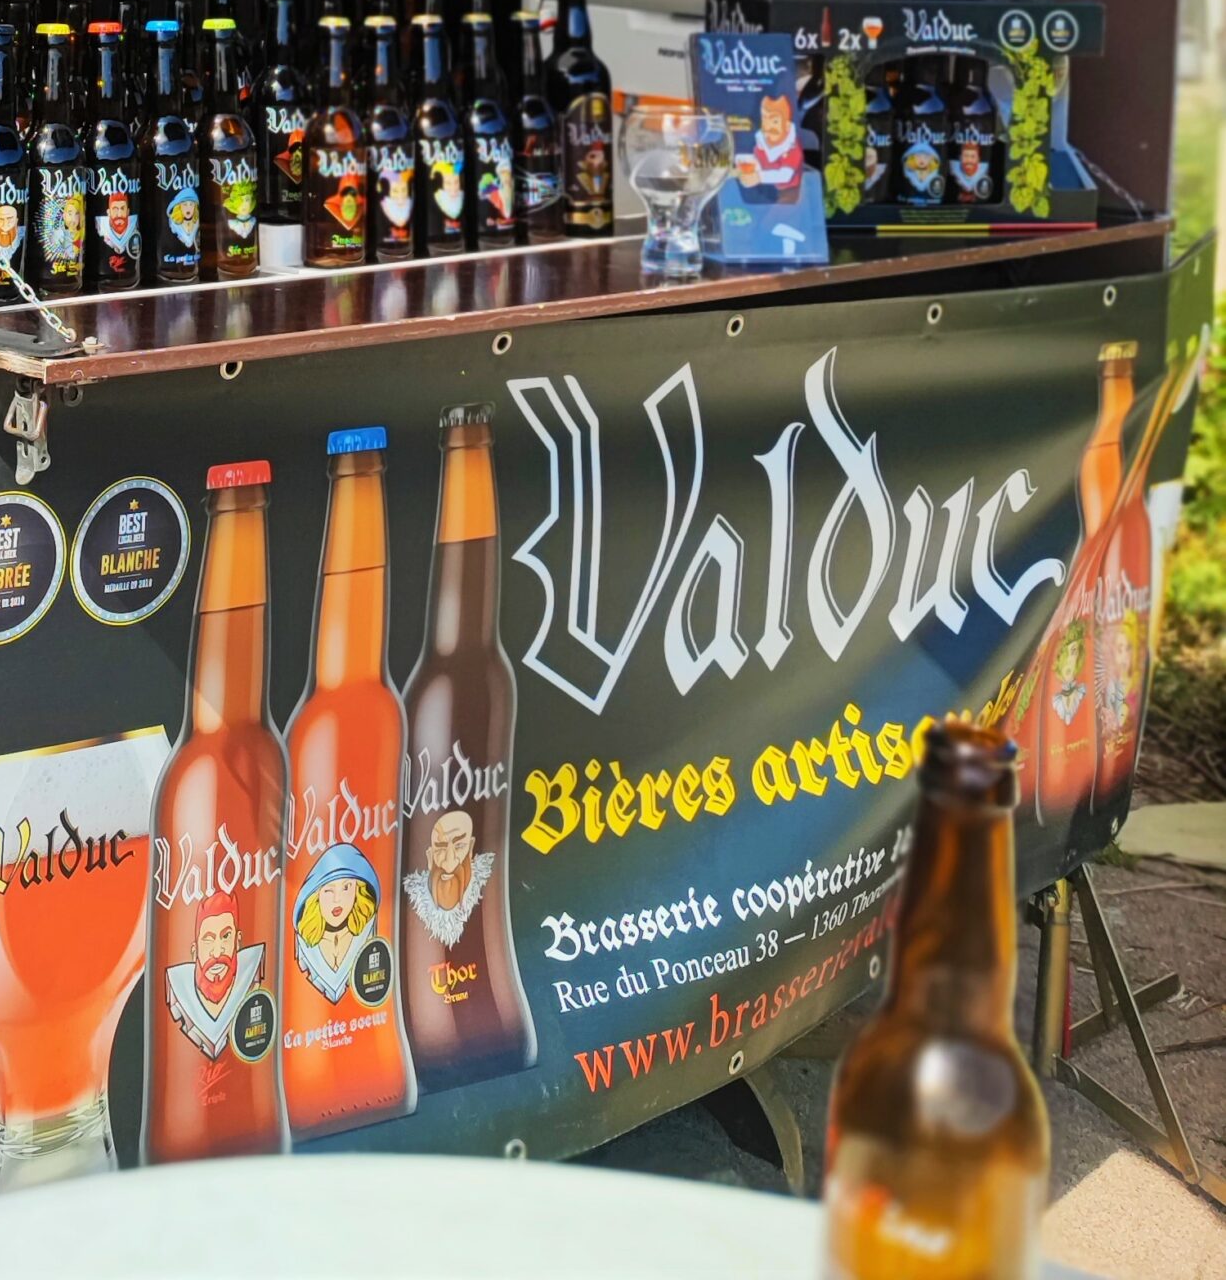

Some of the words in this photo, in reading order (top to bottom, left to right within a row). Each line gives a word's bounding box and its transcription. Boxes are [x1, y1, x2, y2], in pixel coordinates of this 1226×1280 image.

[795, 27, 818, 49] 6x
[838, 26, 861, 51] 2x
[902, 7, 978, 42] Valduc
[699, 38, 787, 75] Valduc
[266, 107, 307, 134] Vald
[87, 167, 141, 196] Valduc
[119, 512, 148, 535] BEST
[506, 345, 1067, 715] Valduc
[101, 548, 161, 576] BLANCHE
[401, 741, 509, 819] Valduc
[521, 754, 735, 855] Bières
[286, 776, 399, 862] Valduc
[153, 822, 281, 910] Valduc
[540, 886, 723, 963] Brasserie
[732, 846, 886, 924] coopérative
[552, 977, 610, 1015] Rue
[614, 965, 649, 995] du
[652, 944, 751, 992] Ponceau
[755, 929, 779, 965] 38
[811, 901, 848, 940] 1360
